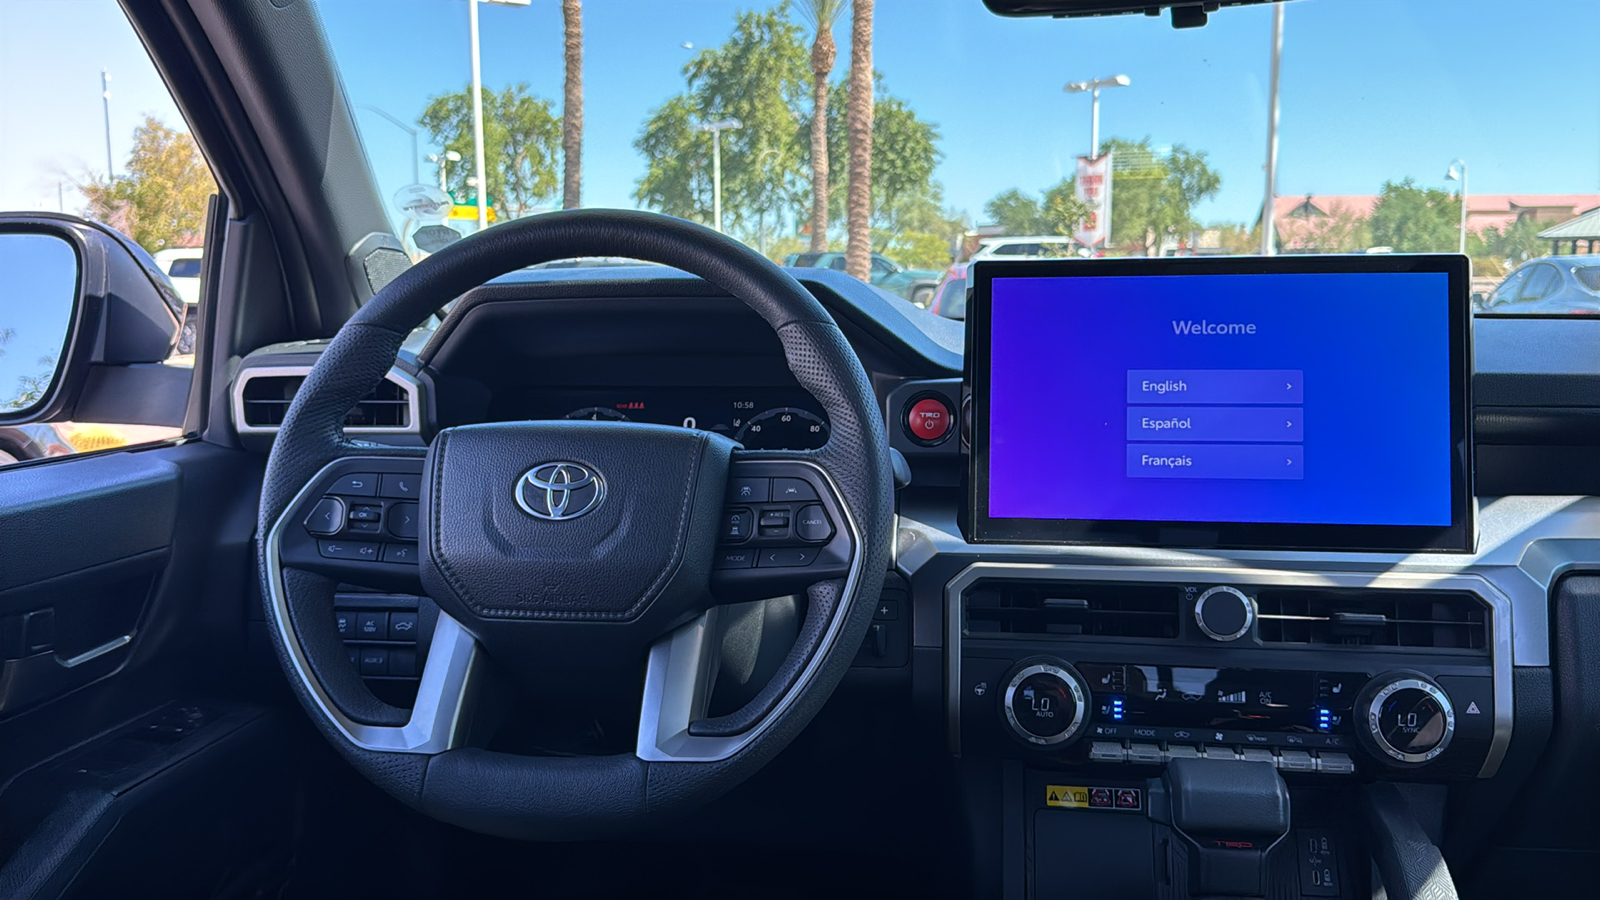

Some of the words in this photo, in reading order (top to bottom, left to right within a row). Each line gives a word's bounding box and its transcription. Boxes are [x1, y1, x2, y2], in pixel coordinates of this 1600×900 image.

[1172, 319, 1257, 335] Welcome
[1141, 380, 1187, 394] English
[733, 401, 754, 409] 10:58
[781, 414, 791, 422] 60
[751, 424, 761, 432] 40
[810, 424, 820, 432] 80
[1141, 417, 1192, 431] Español
[1141, 454, 1192, 468] Français
[1031, 697, 1050, 712] LO
[1035, 710, 1054, 718] AUTO
[1397, 712, 1417, 727] LO
[1104, 727, 1118, 735] OFF
[1133, 728, 1156, 737] MODE
[1402, 726, 1420, 734] SYNC
